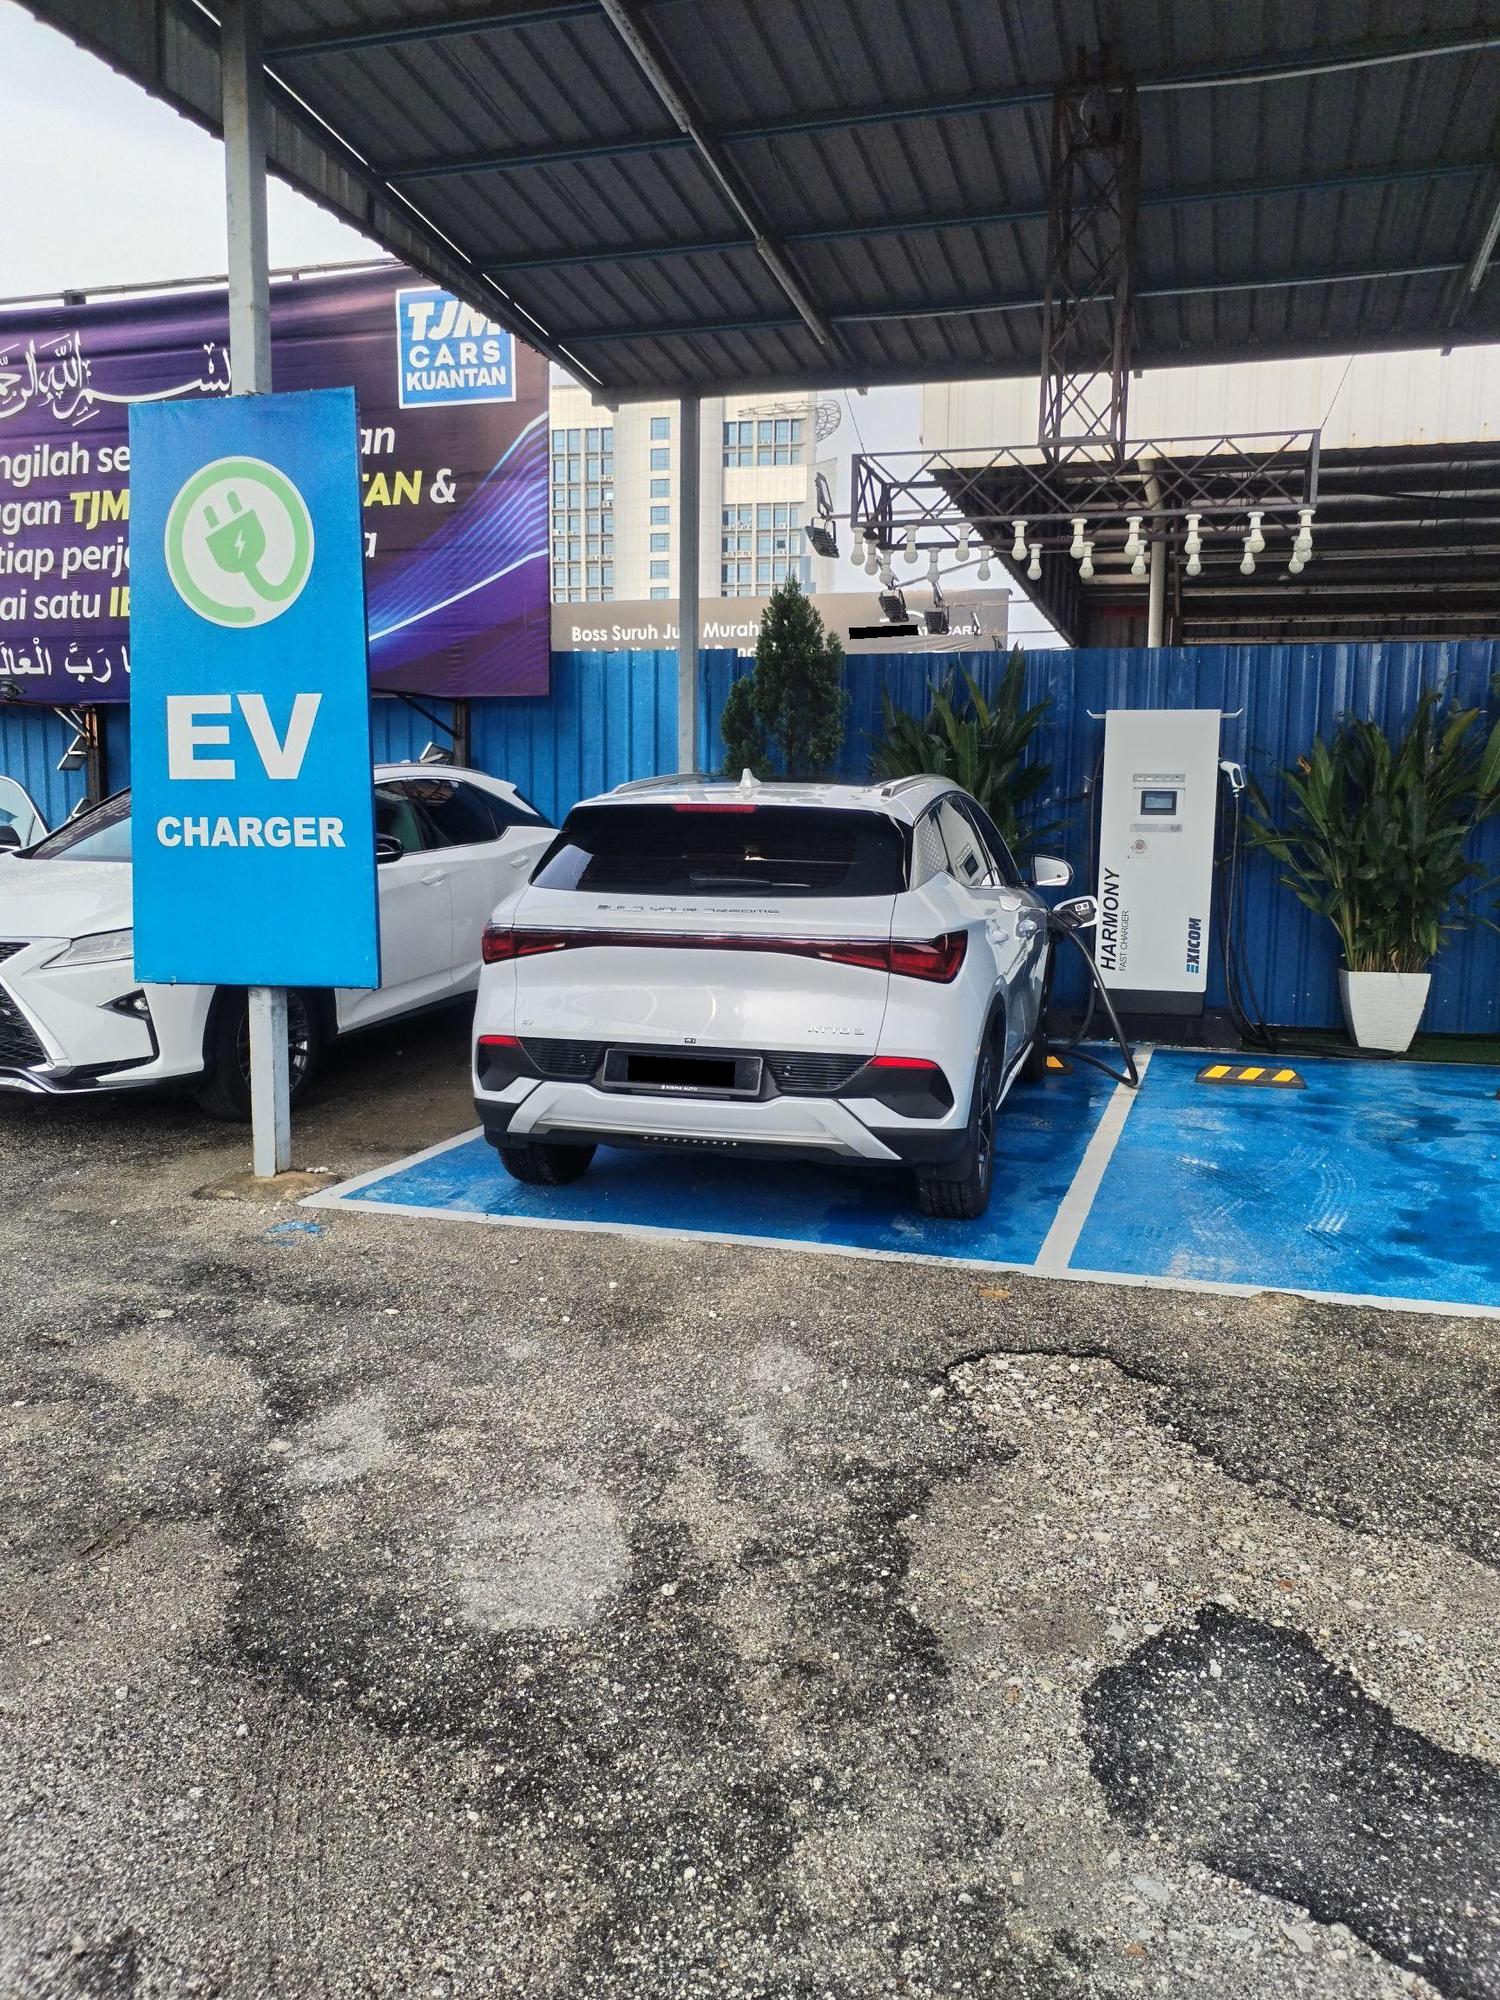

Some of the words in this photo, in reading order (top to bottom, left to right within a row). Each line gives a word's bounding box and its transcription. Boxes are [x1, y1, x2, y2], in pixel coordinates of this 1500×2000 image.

[409, 340, 501, 368] CARS
[406, 366, 506, 391] KUANTAN
[0, 500, 61, 535] gan
[70, 488, 130, 530] TJM
[429, 467, 457, 504] &
[33, 590, 101, 620] satu
[571, 626, 608, 642] Boss
[612, 624, 658, 641] Suruh
[166, 693, 323, 780] EV
[156, 816, 346, 848] CHARGER
[1100, 867, 1120, 971] HARMONY
[1120, 910, 1130, 950] CHARGER
[1185, 917, 1202, 974] EXICOM
[1119, 952, 1128, 972] FAST
